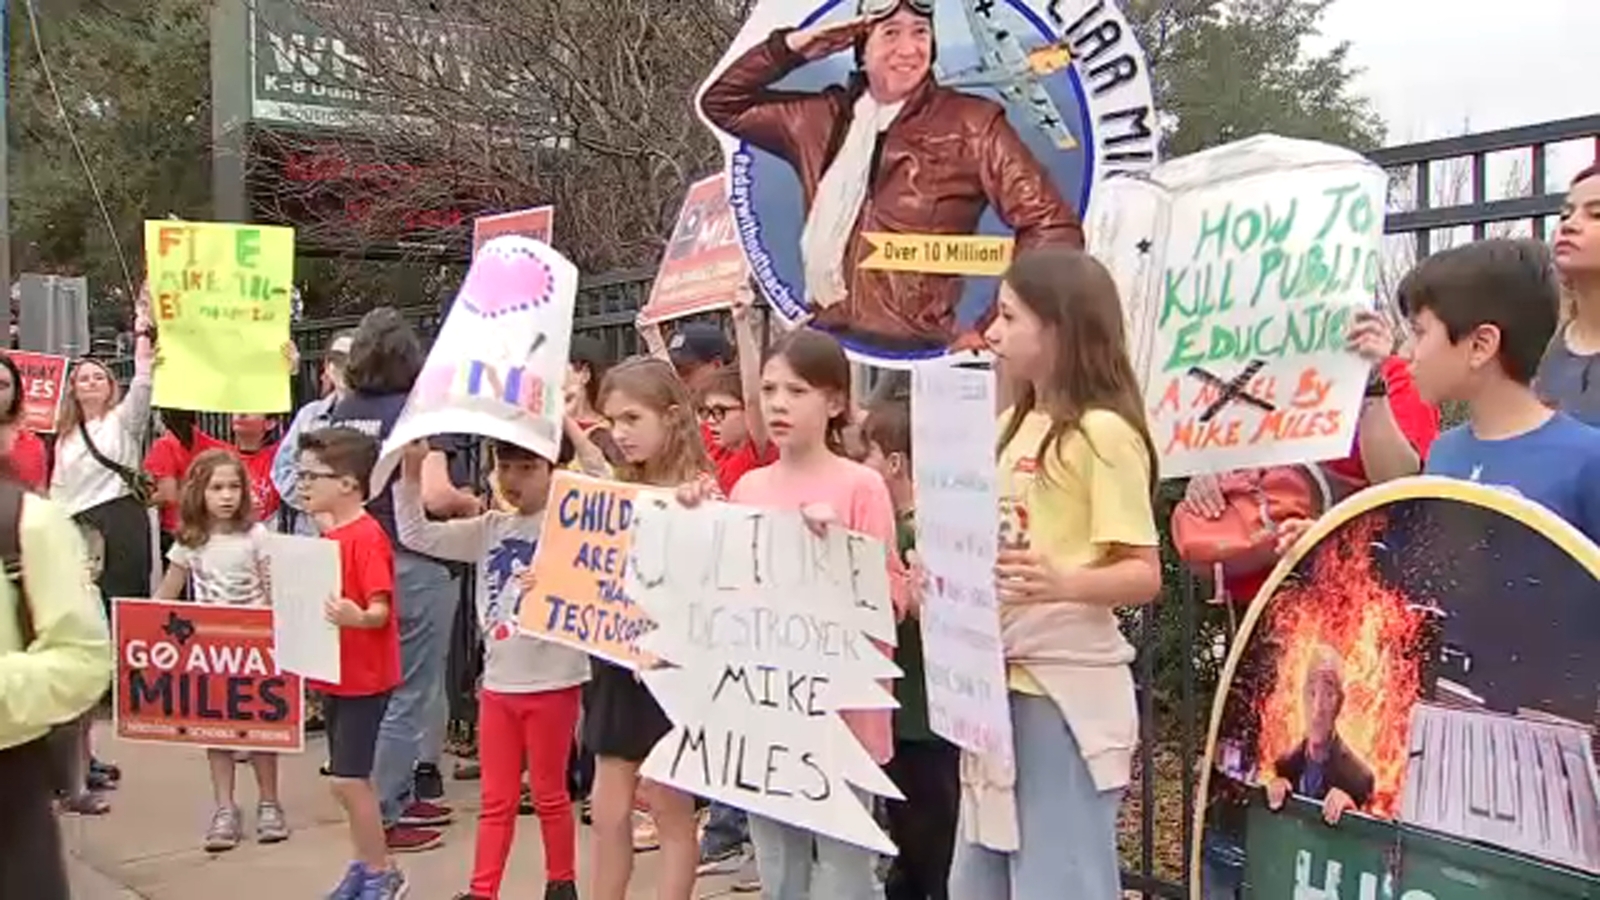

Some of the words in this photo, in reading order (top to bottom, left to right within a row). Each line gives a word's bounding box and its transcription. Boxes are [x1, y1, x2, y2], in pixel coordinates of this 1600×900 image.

[1101, 105, 1154, 163] MI
[159, 226, 261, 268] FIE
[1194, 197, 1298, 259] HOW
[1315, 182, 1373, 240] TO
[884, 241, 919, 261] Over
[924, 242, 941, 262] 10
[947, 242, 1005, 262] Million!
[1159, 258, 1235, 328] KILL
[1251, 243, 1377, 307] PUBLIC
[1163, 303, 1352, 372] EDUCATIO
[1156, 377, 1181, 415] A
[1191, 374, 1277, 409] NEL
[1165, 412, 1243, 456] MIKE
[1249, 408, 1342, 445] MILES
[573, 541, 618, 575] ARE
[545, 595, 608, 643] TEST
[687, 600, 862, 661] DESTROYER
[126, 638, 179, 670] GO
[129, 669, 290, 723] MILES
[712, 664, 830, 717] MIKE
[670, 725, 833, 802] MILES
